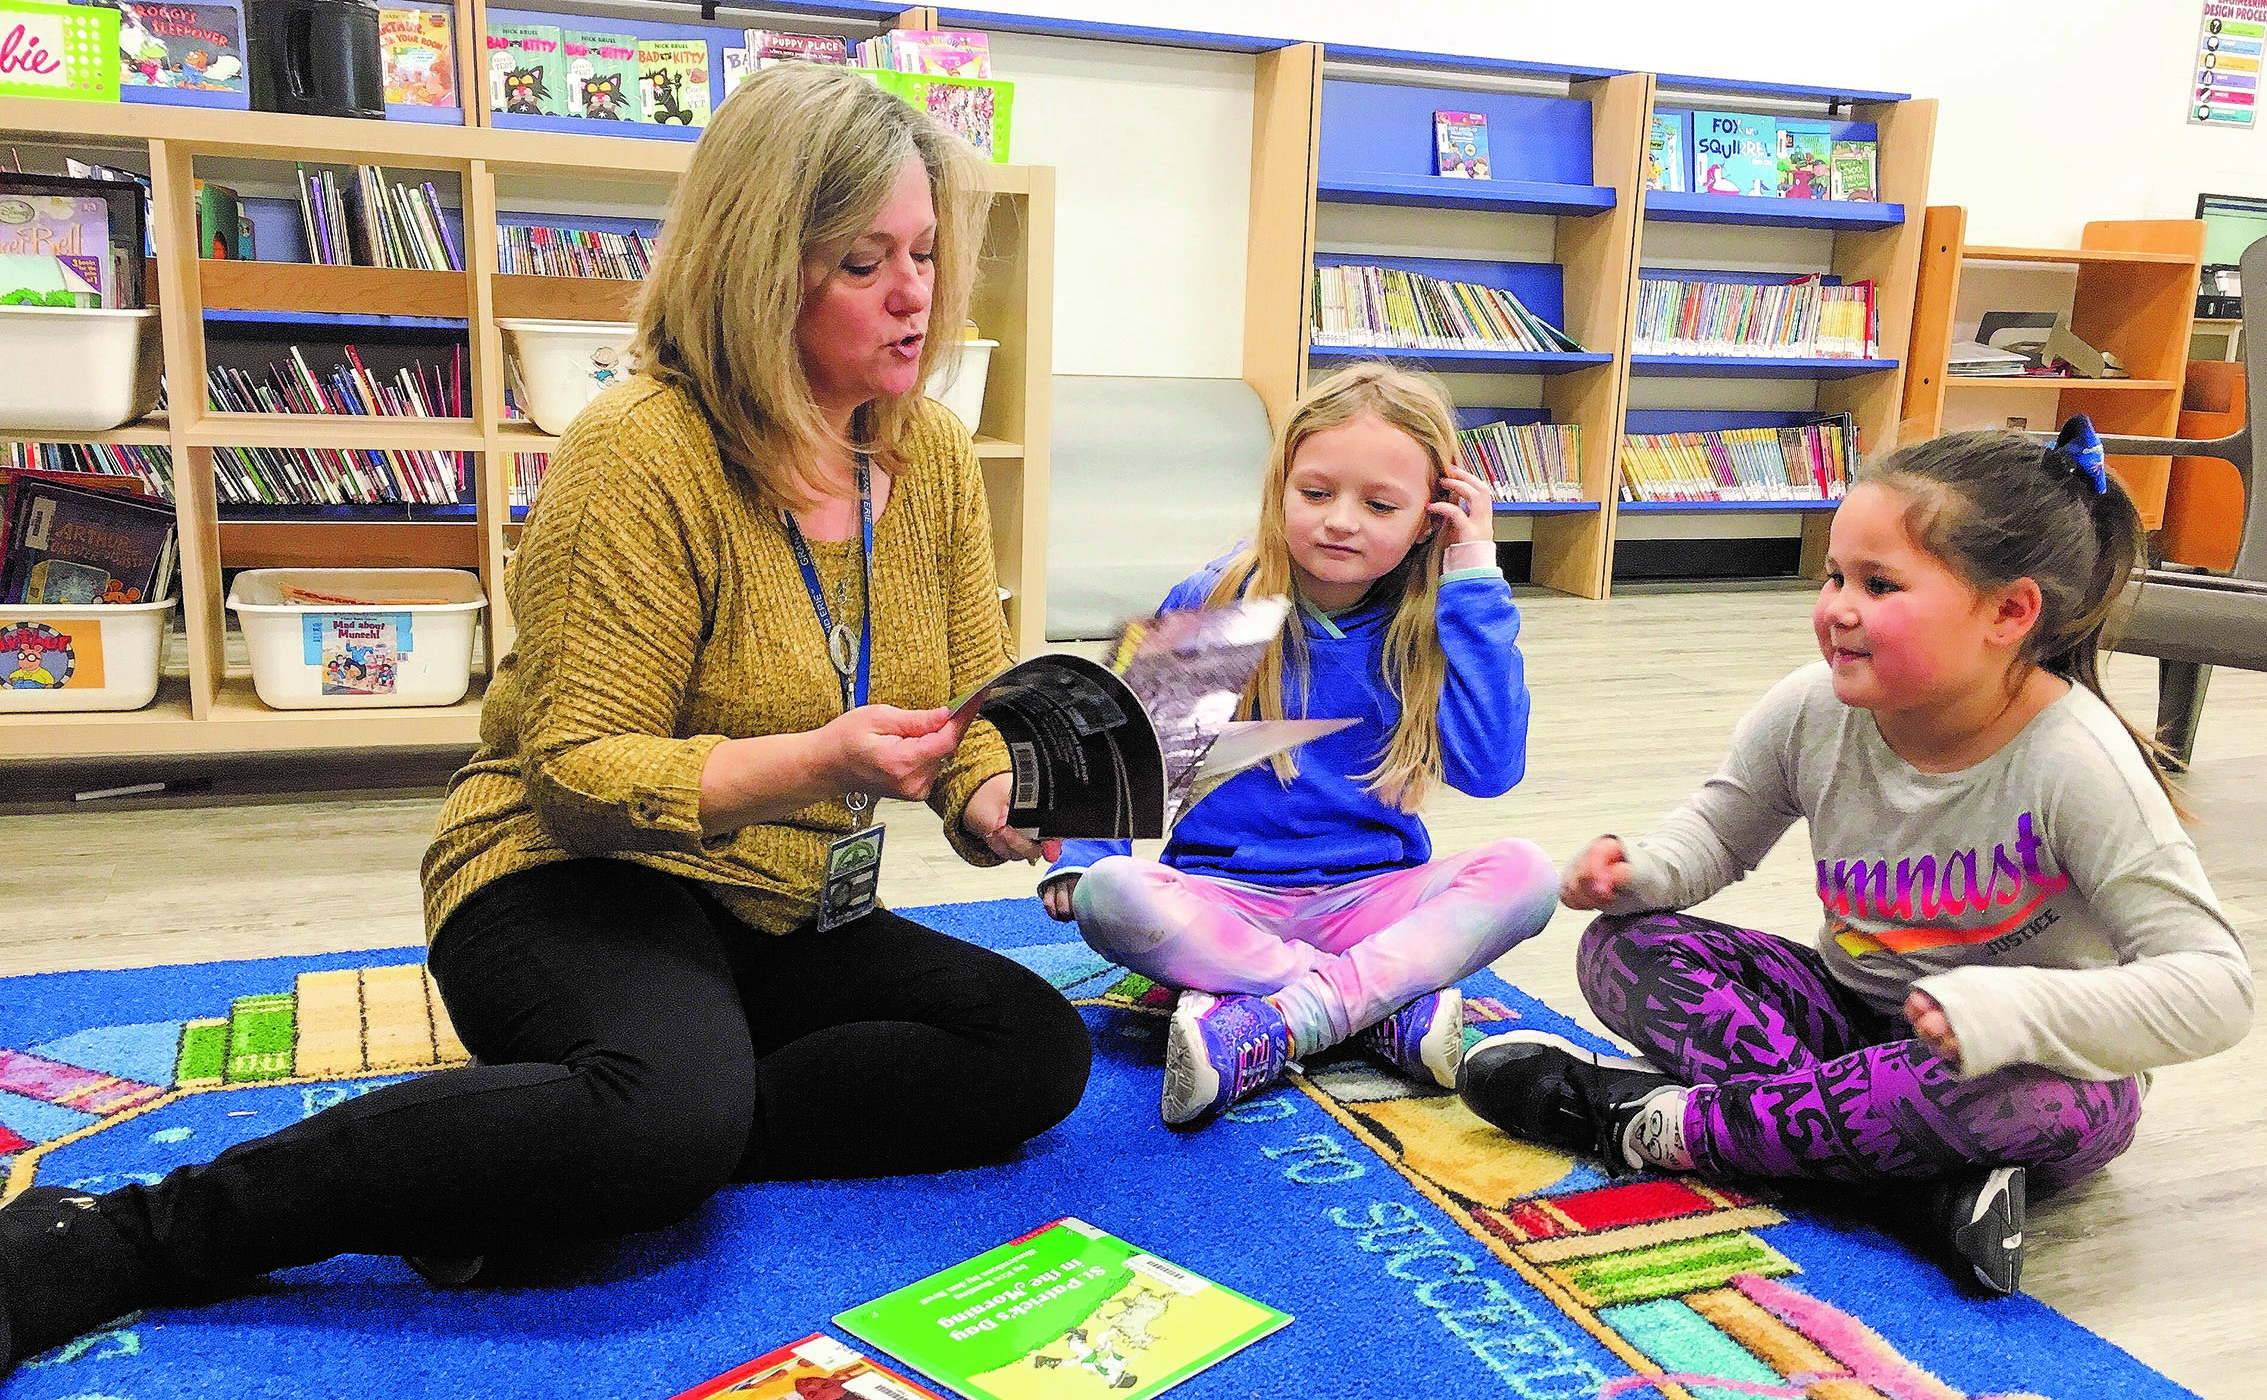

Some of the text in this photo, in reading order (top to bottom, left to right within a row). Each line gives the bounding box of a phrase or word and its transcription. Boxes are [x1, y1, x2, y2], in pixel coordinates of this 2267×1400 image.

[132, 4, 197, 24] ROGGY'S
[2204, 3, 2234, 18] DESIGN
[151, 19, 228, 47] SLEEPOVER
[396, 34, 419, 43] YOUR
[487, 36, 557, 53] BAD KITTY
[564, 41, 634, 61] BAD KITTY
[772, 38, 839, 52] PUPPY PLACE
[638, 50, 705, 64] BAD KITTY
[687, 101, 706, 109] VET
[1713, 118, 1743, 134] FOX
[863, 501, 872, 524] ERIE
[332, 620, 386, 631] Mad about
[338, 629, 380, 639] Munsch!
[1985, 908, 2060, 957] JUSTICE
[1081, 1264, 1107, 1283] St.
[936, 1257, 1085, 1329] in the Morning
[996, 1277, 1087, 1322] Patrick's
[949, 1317, 1000, 1342] Day
